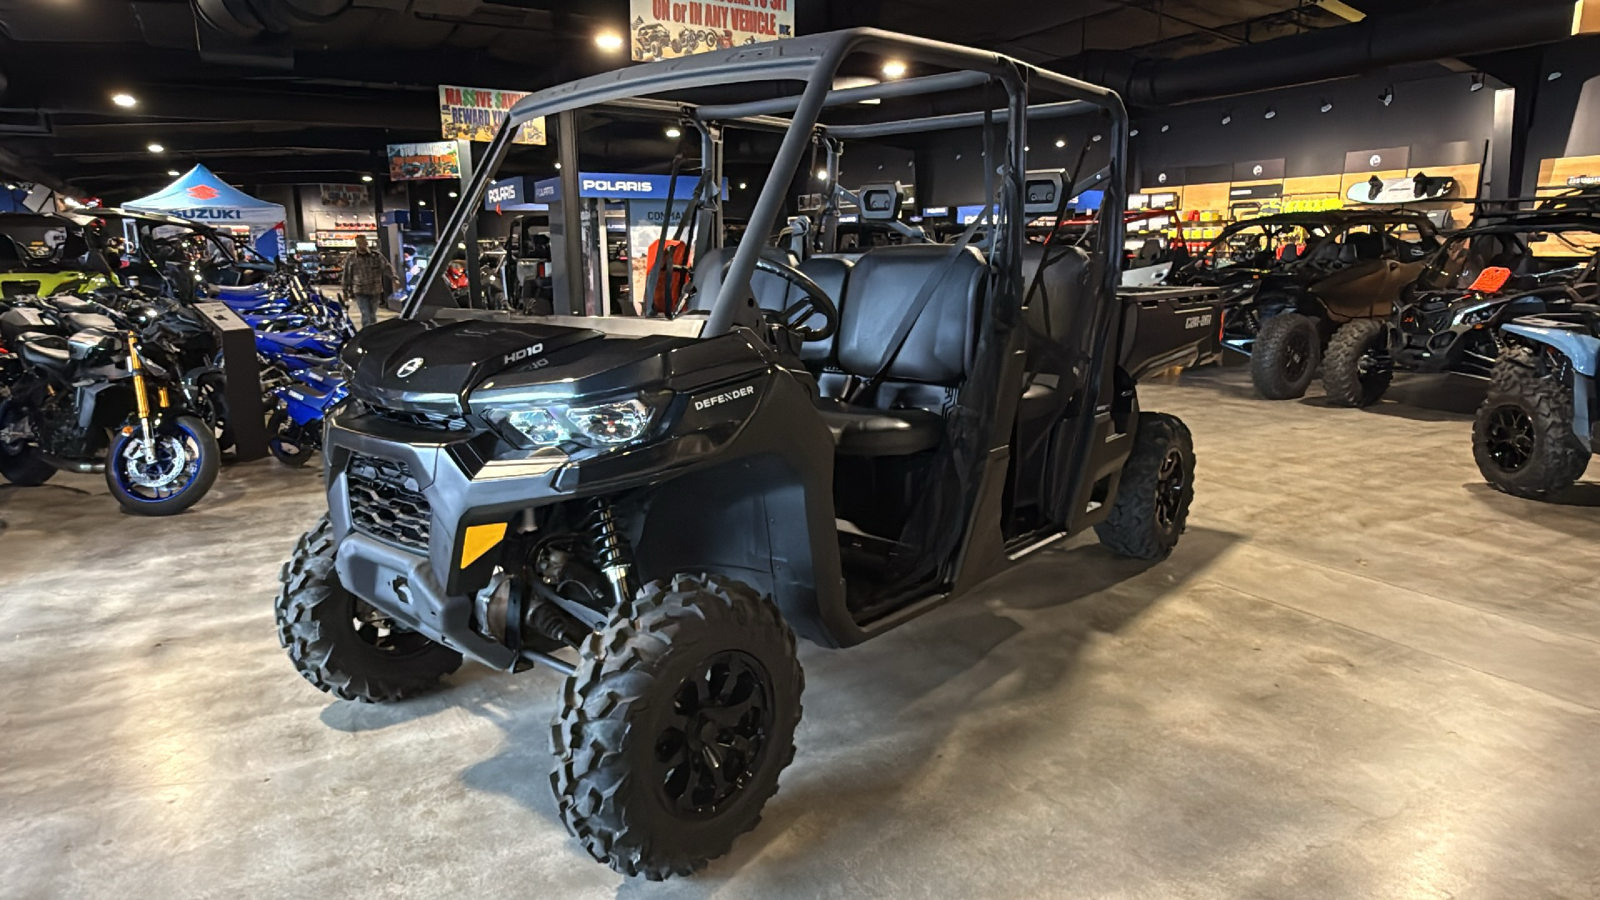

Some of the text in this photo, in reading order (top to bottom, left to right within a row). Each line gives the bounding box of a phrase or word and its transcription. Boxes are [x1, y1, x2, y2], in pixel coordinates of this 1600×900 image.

[652, 0, 670, 21] ON
[689, 1, 702, 26] IN
[704, 3, 729, 29] ANY
[731, 8, 777, 36] VEHICLE
[451, 106, 491, 127] REWARD
[488, 184, 516, 204] POLARIS
[583, 179, 652, 192] POLARIS
[168, 208, 241, 219] SUZUKI
[276, 227, 287, 264] SUZU
[504, 343, 543, 365] HD10
[694, 385, 754, 411] DEFENDER
